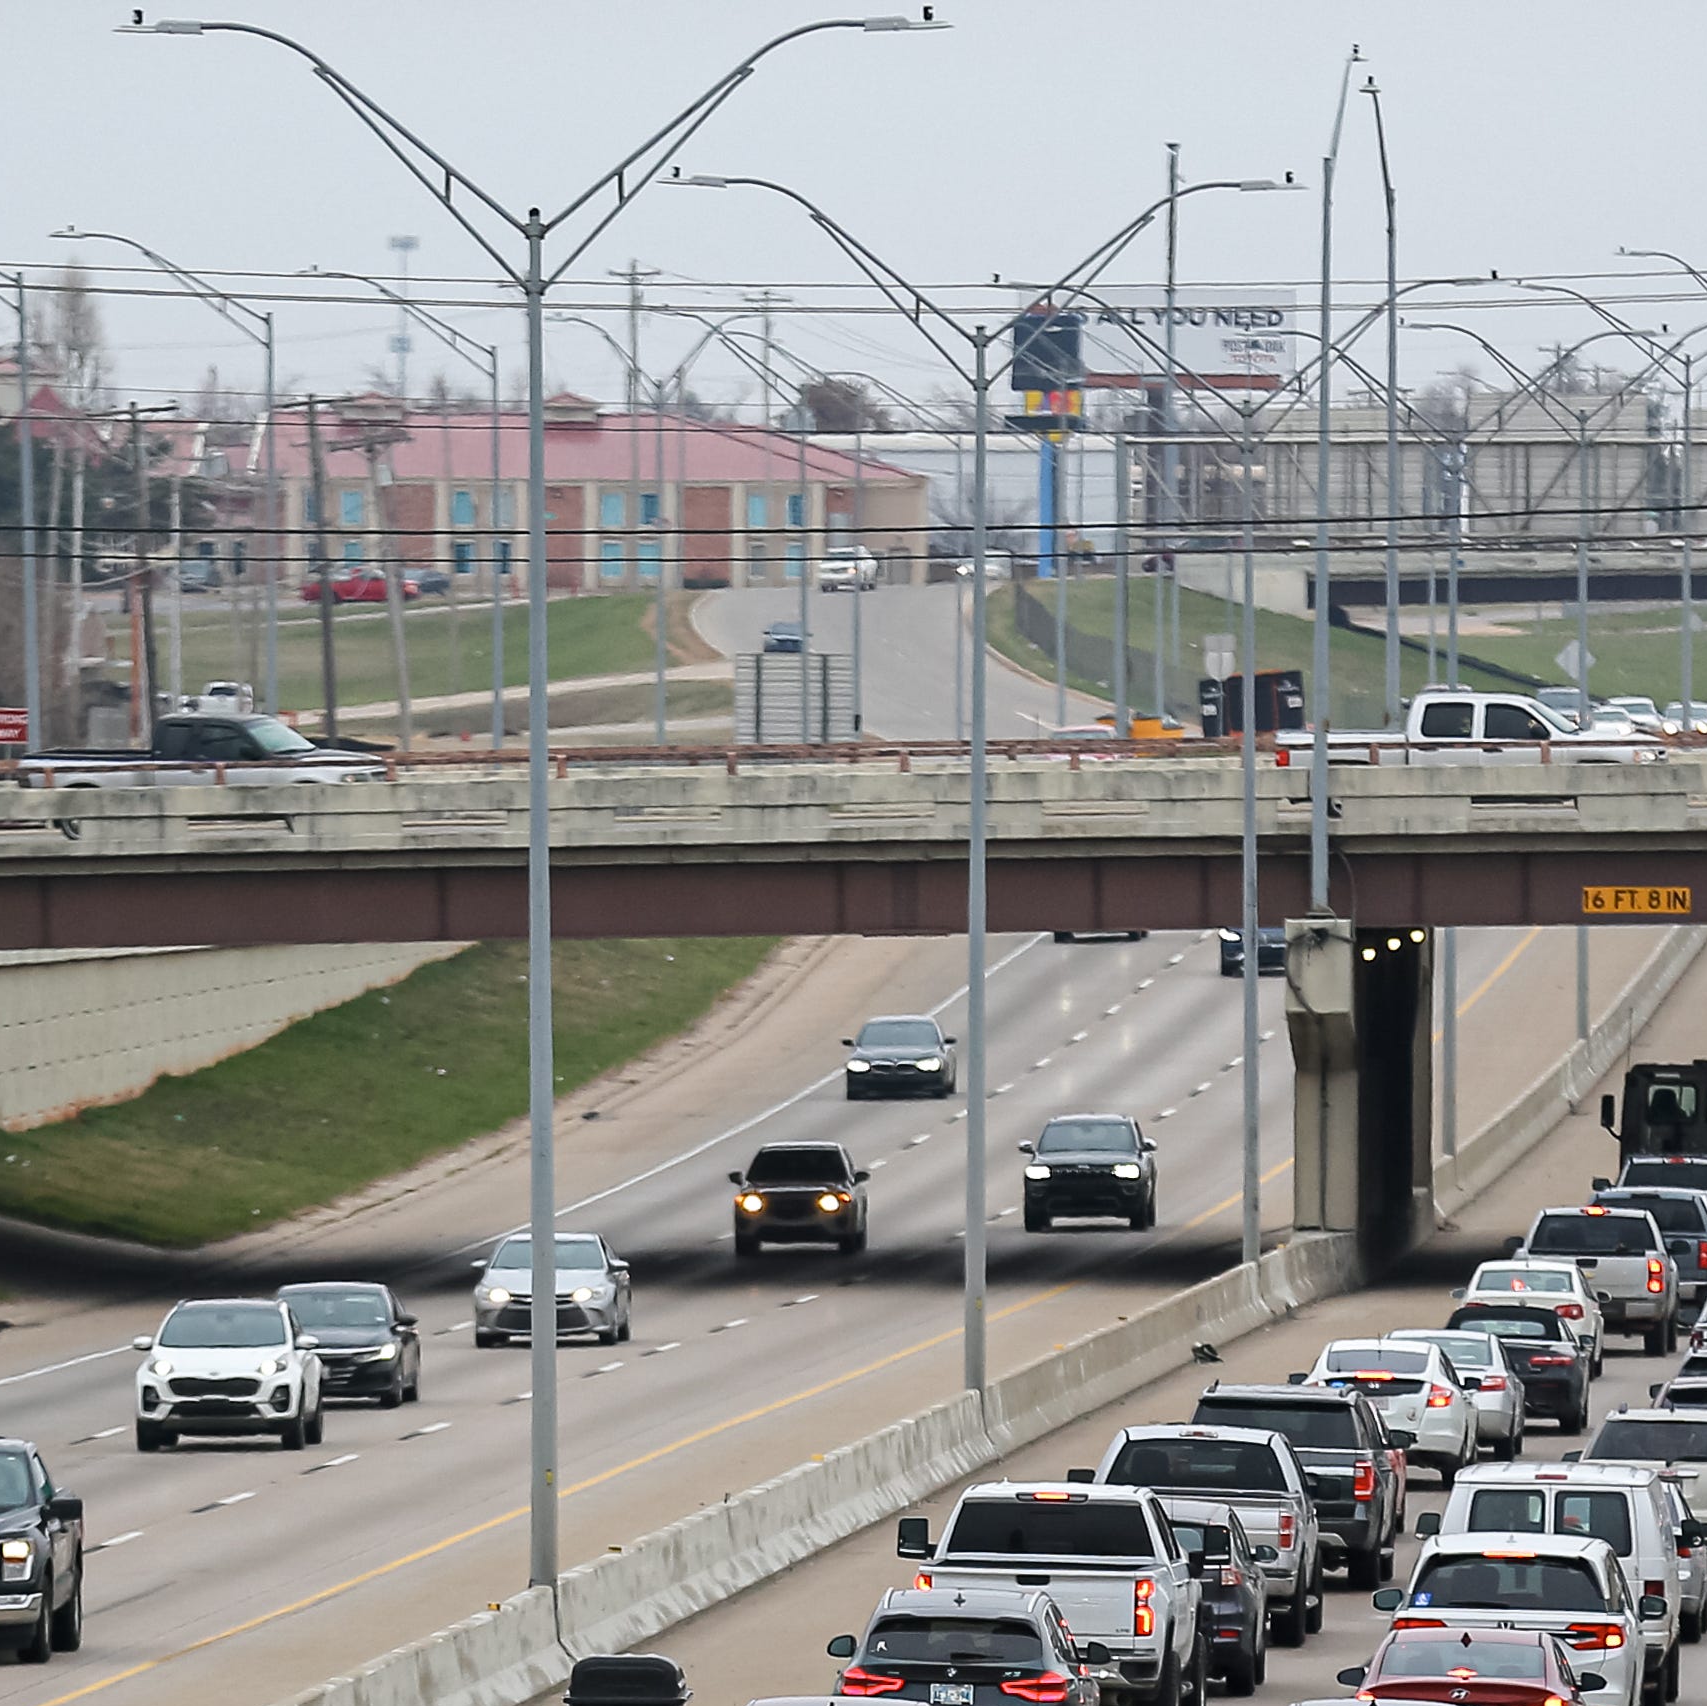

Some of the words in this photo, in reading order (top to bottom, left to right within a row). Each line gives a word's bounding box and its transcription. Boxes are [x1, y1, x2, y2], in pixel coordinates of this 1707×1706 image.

[1214, 308, 1284, 327] NEED
[1583, 891, 1604, 910] 16
[1614, 890, 1643, 909] FT.
[1648, 890, 1662, 909] 8
